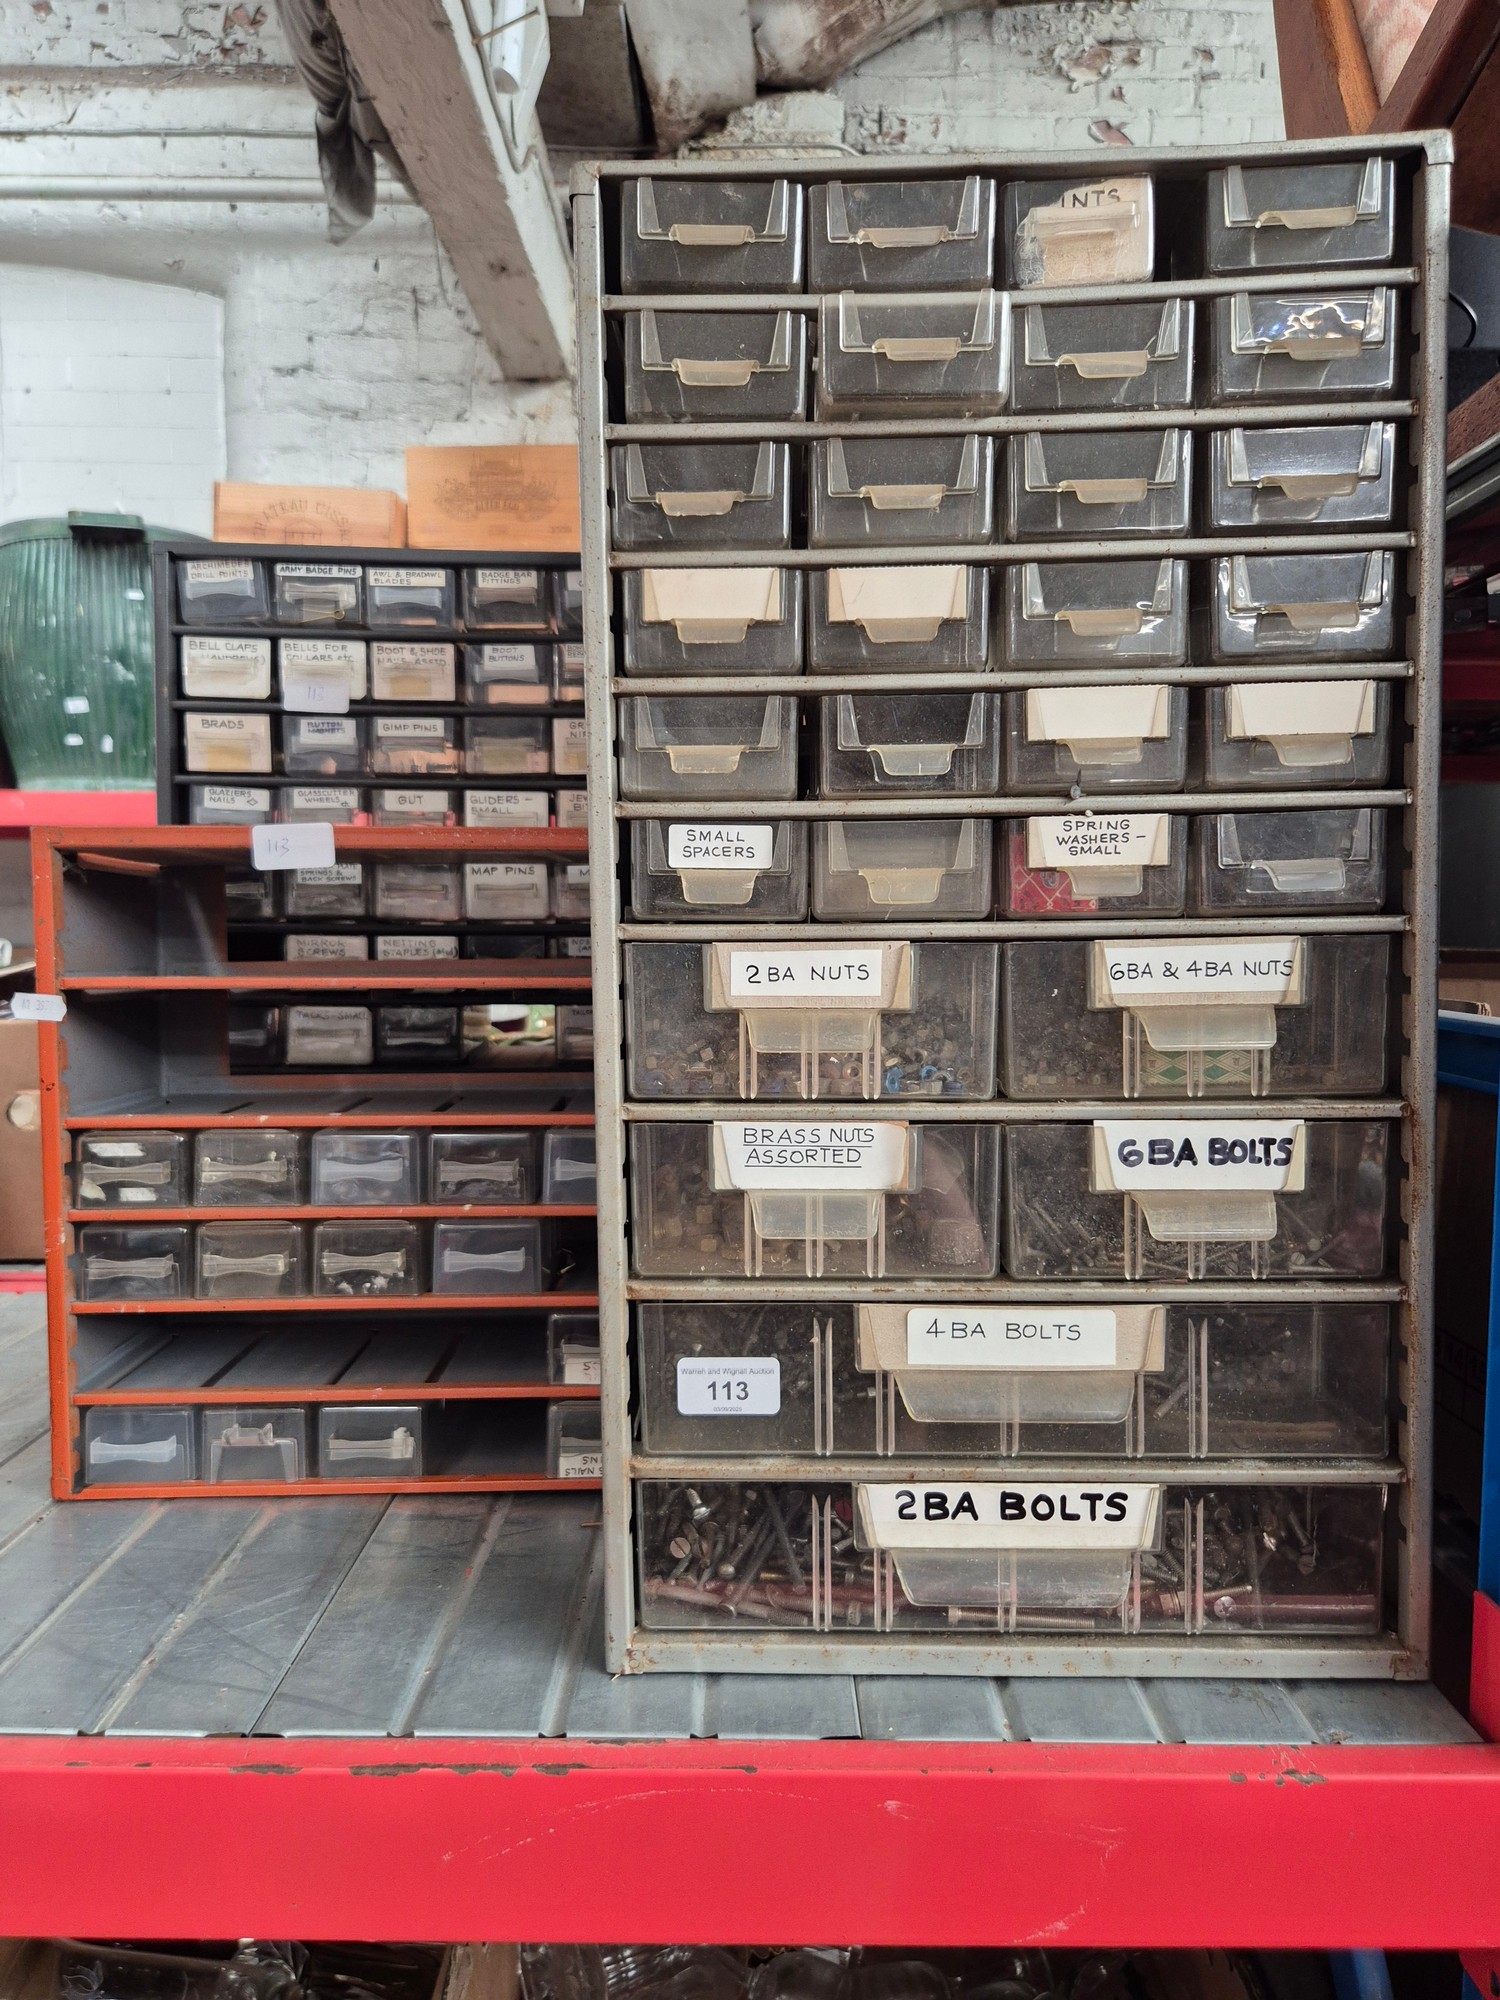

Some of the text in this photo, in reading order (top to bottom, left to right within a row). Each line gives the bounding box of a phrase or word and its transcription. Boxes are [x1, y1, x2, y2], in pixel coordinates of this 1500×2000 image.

[191, 570, 248, 579] DRILL POINTS
[280, 566, 357, 576] ARMY BADGE PINS
[189, 640, 258, 653] BELL CLAPS
[284, 642, 349, 653] BELLS FOR
[376, 646, 447, 656] BOOT & SHOE
[201, 719, 245, 729] BRADS
[382, 724, 438, 732] GIMP PINS
[569, 721, 586, 730] GR
[208, 788, 252, 796] GLAZIERS
[209, 796, 236, 804] NAILS
[304, 796, 340, 804] WHEELS
[397, 795, 424, 805] GUT
[470, 795, 520, 805] GLIDERS
[471, 806, 514, 815] SMALL
[1062, 819, 1130, 832] SPRING
[686, 829, 745, 842] SMALL
[1056, 832, 1130, 846] WASHERS
[268, 838, 290, 858] 113
[682, 845, 755, 858] SPACERS
[1068, 845, 1121, 856] SMALL
[471, 866, 536, 876] MAP PINS
[810, 964, 870, 981] NUTS
[1109, 960, 1294, 981] 6BA & 4BA NUTS
[743, 1127, 875, 1144] BRASS NUTS
[746, 1148, 861, 1165] ASSORTED
[1117, 1137, 1294, 1168] 6BA BOLTS
[926, 1318, 1081, 1341] 4BA BOLTS
[722, 1368, 747, 1377] Wignall
[707, 1381, 749, 1400] 113
[565, 1467, 595, 1477] NAILS
[895, 1490, 1129, 1522] 2BA BOLTS
